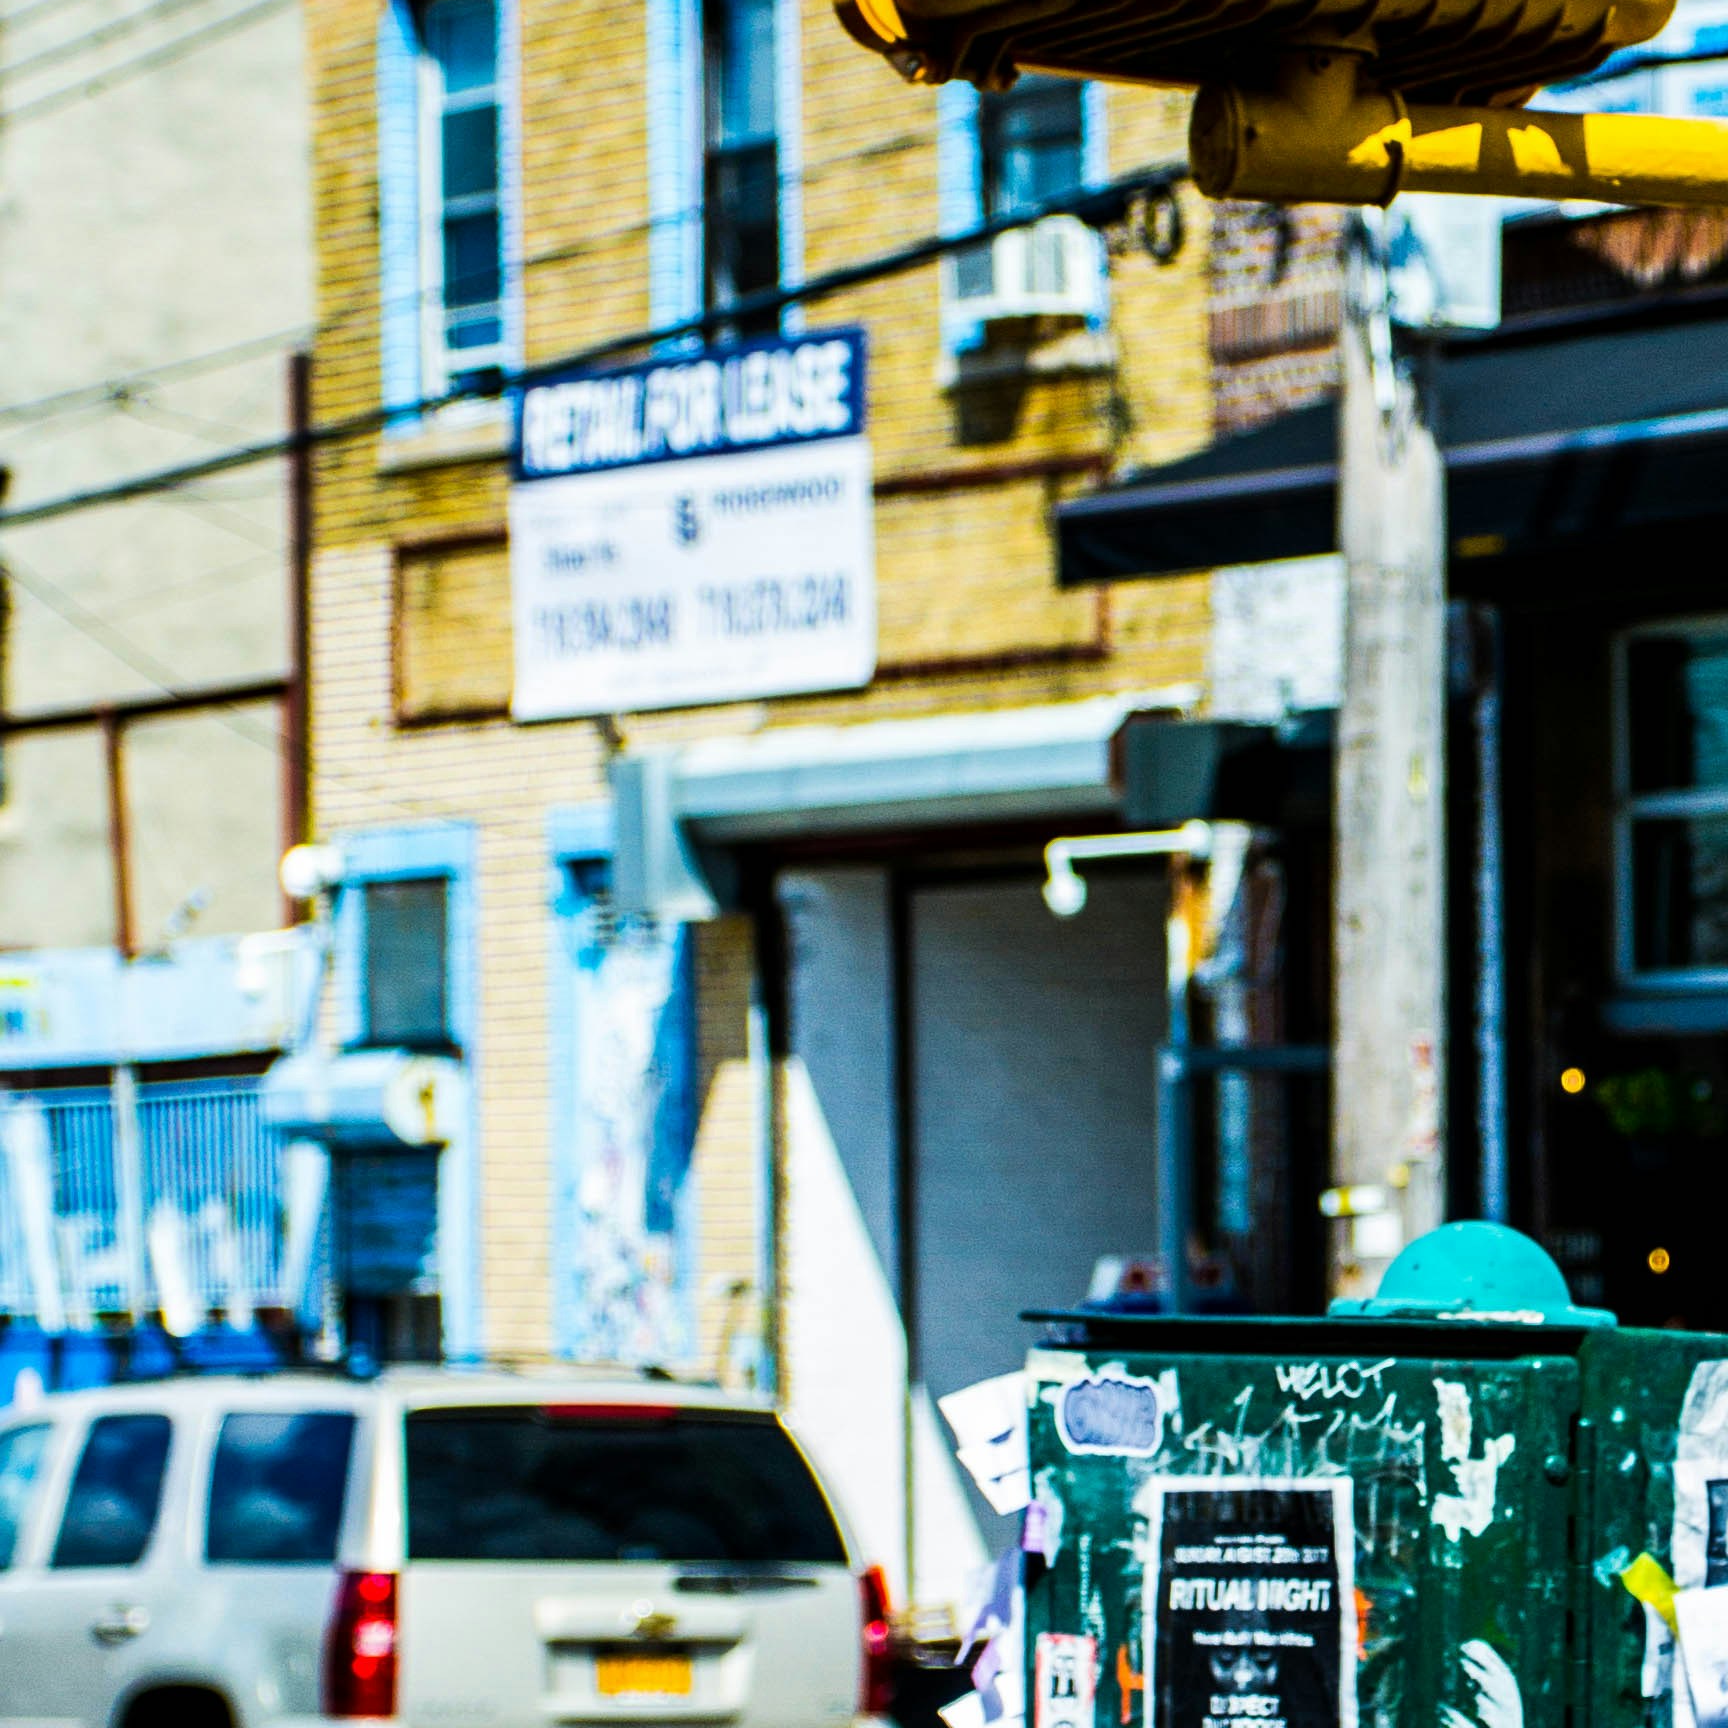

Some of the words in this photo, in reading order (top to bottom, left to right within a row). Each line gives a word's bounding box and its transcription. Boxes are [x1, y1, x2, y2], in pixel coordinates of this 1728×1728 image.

[645, 360, 721, 452] FOR
[725, 339, 853, 443] LEASE
[1169, 1577, 1253, 1612] RITUAL
[1256, 1578, 1332, 1612] NIGHT
